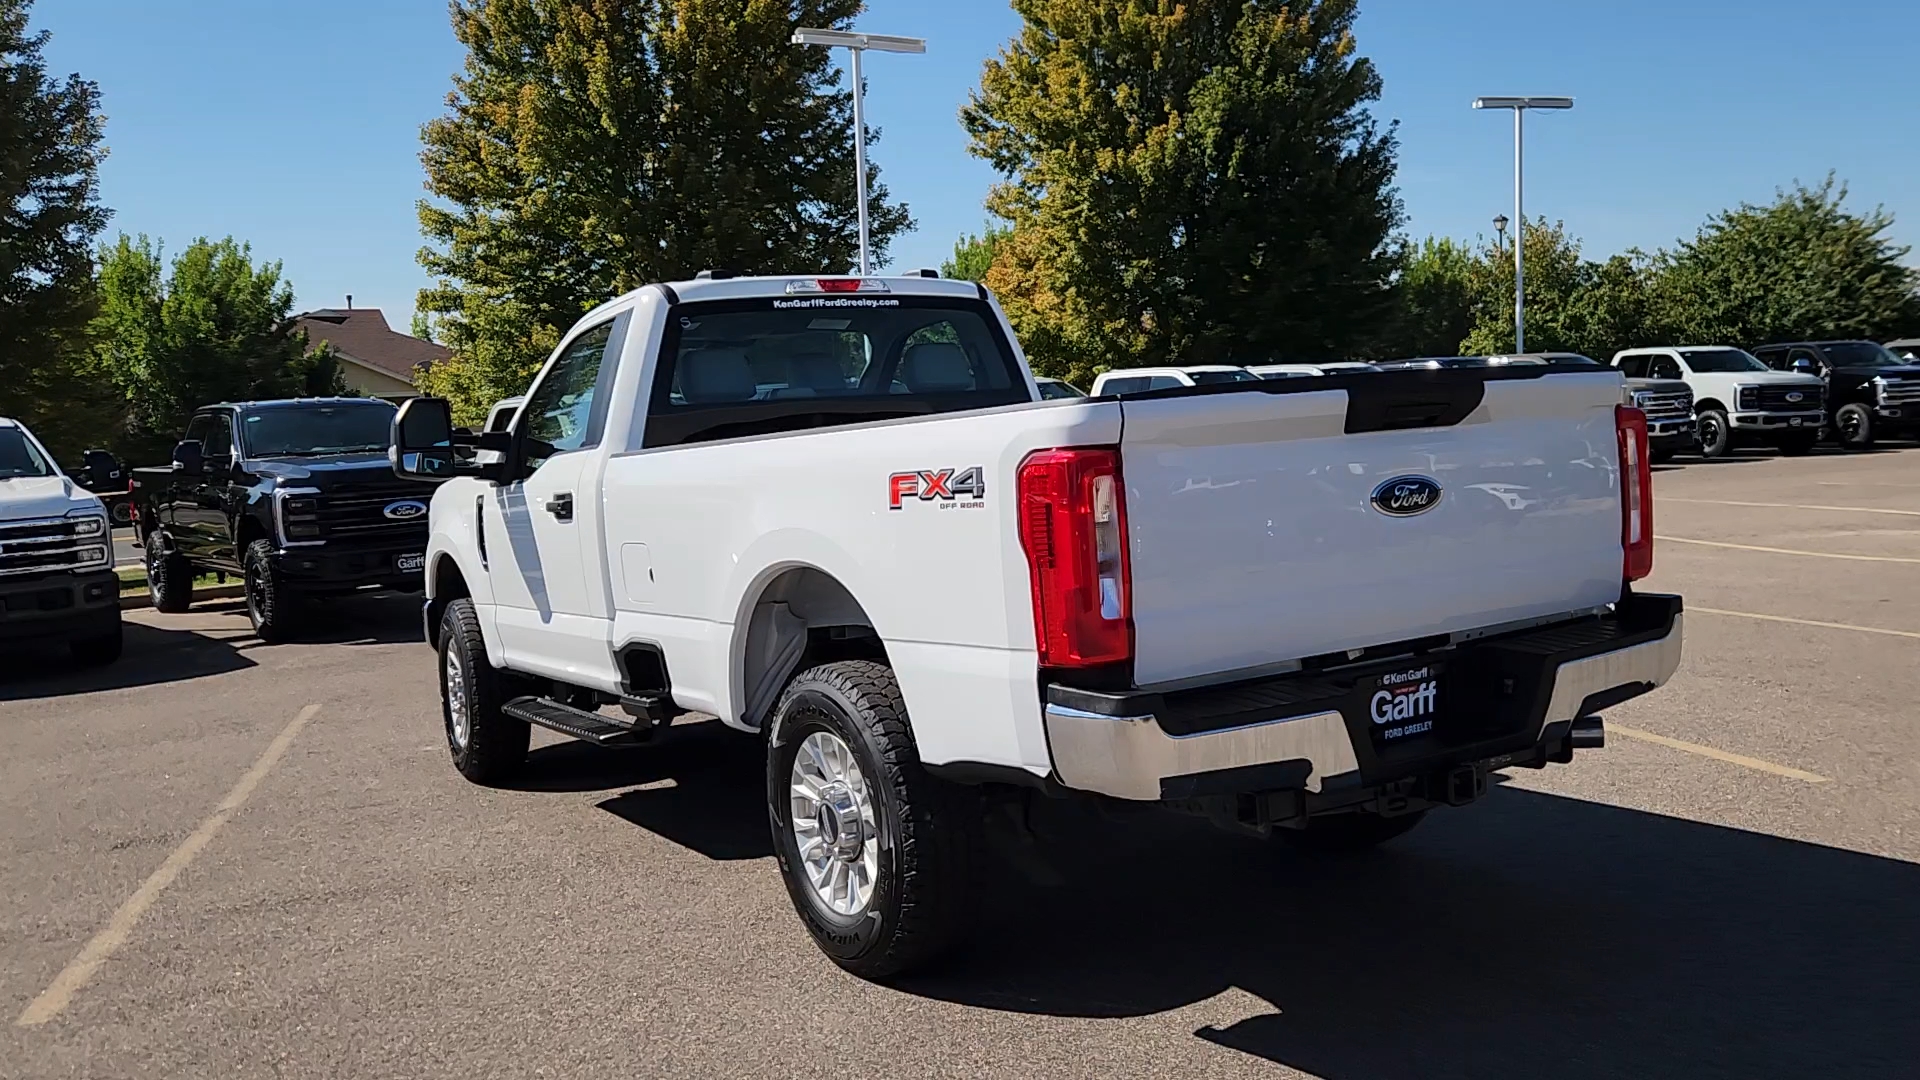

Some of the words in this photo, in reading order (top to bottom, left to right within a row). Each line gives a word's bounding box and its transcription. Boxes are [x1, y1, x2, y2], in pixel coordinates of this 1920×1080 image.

[773, 299, 899, 309] KenGarffFordGreeley.com
[889, 466, 985, 510] FX4
[1391, 484, 1429, 508] Ford
[396, 506, 416, 516] Ford
[940, 502, 957, 510] OFF
[960, 501, 985, 509] ROAD
[397, 556, 425, 569] Garff
[1391, 672, 1407, 684] Ken
[1407, 667, 1428, 681] Garff
[1371, 680, 1437, 724] Garff
[1384, 727, 1403, 740] FORD
[1404, 720, 1433, 736] GREELEY
